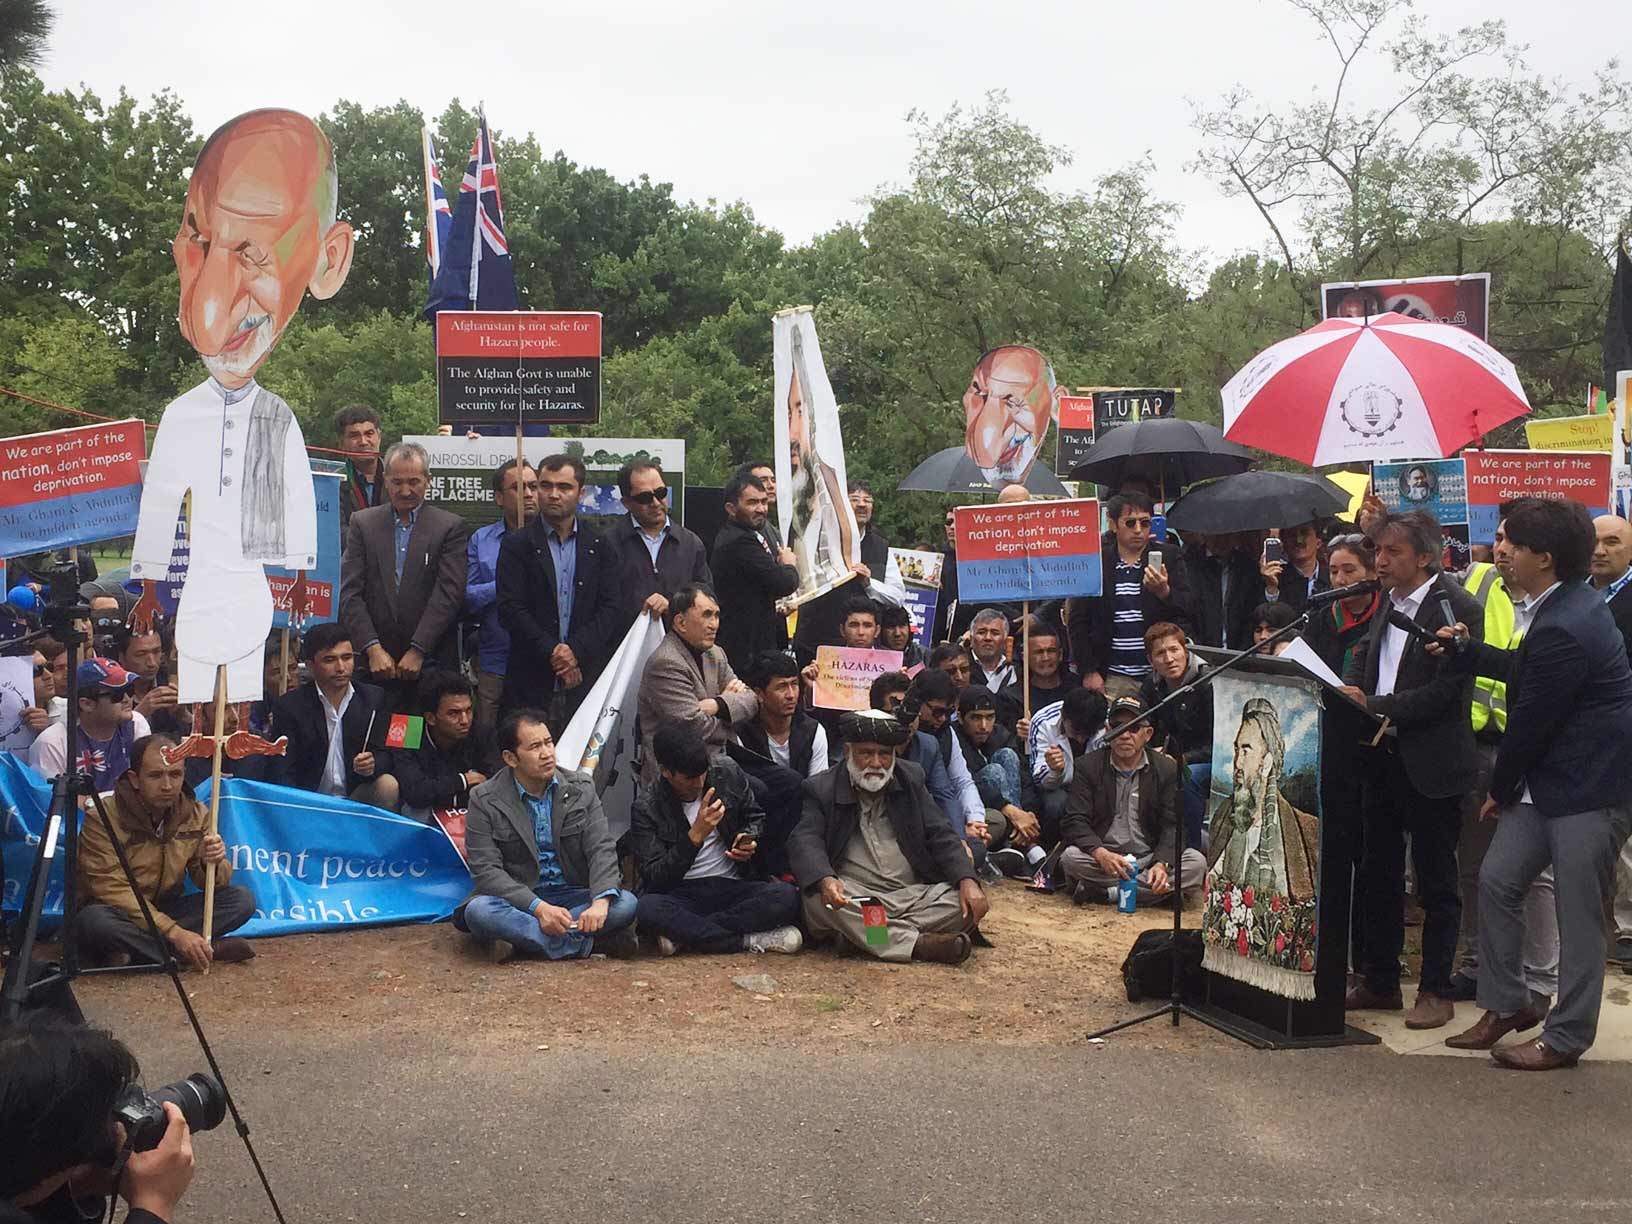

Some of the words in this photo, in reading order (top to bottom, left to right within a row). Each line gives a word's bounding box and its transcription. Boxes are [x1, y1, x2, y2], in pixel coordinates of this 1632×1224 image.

[451, 320, 515, 332] Afghanistan
[518, 320, 526, 332] is
[528, 322, 547, 332] not
[550, 320, 571, 332] safe
[573, 320, 590, 332] for
[480, 335, 519, 348] Hazara
[520, 336, 561, 350] people.
[448, 367, 471, 379] The
[474, 367, 513, 380] Afghan
[516, 367, 543, 380] Govt
[545, 367, 554, 379] is
[556, 367, 592, 379] unable
[464, 385, 476, 395] to
[479, 383, 520, 397] provide
[523, 383, 551, 396] safety
[555, 383, 576, 395] and
[455, 400, 498, 413] security
[500, 399, 516, 410] for
[539, 399, 585, 411] Hazaras.
[6, 448, 28, 460] We
[31, 445, 53, 456] are
[56, 439, 83, 456] part
[86, 434, 101, 447] of
[104, 432, 126, 444] the
[2, 464, 54, 481] nation,
[57, 457, 88, 472] don't
[91, 451, 133, 467] impose
[429, 453, 486, 467] NROSSIL
[1479, 458, 1499, 468] We
[1502, 460, 1521, 468] are
[1525, 460, 1549, 471] part
[1553, 459, 1568, 469] of
[1571, 459, 1592, 469] the
[33, 472, 106, 493] deprivation.
[427, 476, 446, 488] NE
[447, 477, 482, 489] TREE
[1472, 474, 1520, 486] nation,
[1524, 475, 1552, 485] don't
[1556, 478, 1597, 488] impose
[423, 489, 495, 501] EPLACEME
[972, 513, 992, 524] We
[994, 514, 1014, 522] are
[1017, 509, 1041, 524] part
[1044, 508, 1057, 518] of
[1060, 507, 1080, 517] the
[968, 528, 1015, 540] nation,
[1017, 525, 1045, 538] don't
[1048, 524, 1087, 537] impose
[995, 541, 1061, 554] deprivation.
[320, 586, 330, 597] is
[832, 661, 885, 672] HAZARAS
[255, 899, 380, 923] ossible
